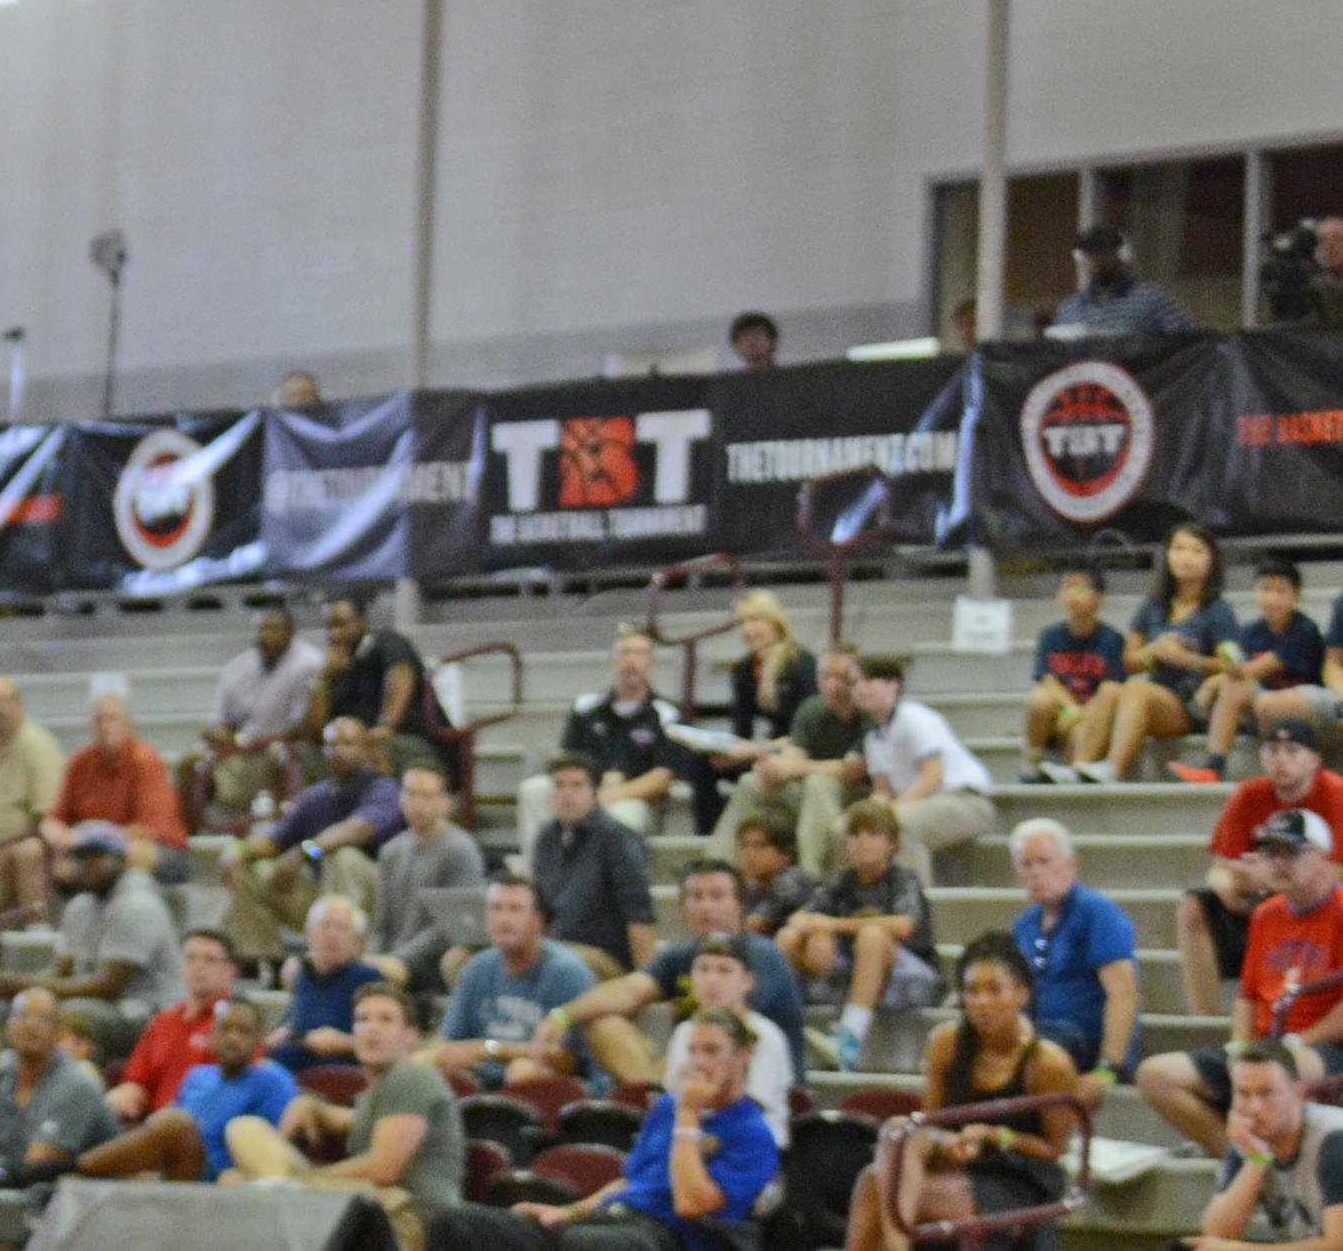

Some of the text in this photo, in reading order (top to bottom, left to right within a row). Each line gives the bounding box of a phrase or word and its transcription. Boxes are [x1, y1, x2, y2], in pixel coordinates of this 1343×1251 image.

[489, 407, 714, 513] TBT
[725, 429, 957, 484] THETOURNAMENT.COM
[1041, 422, 1127, 459] TBT
